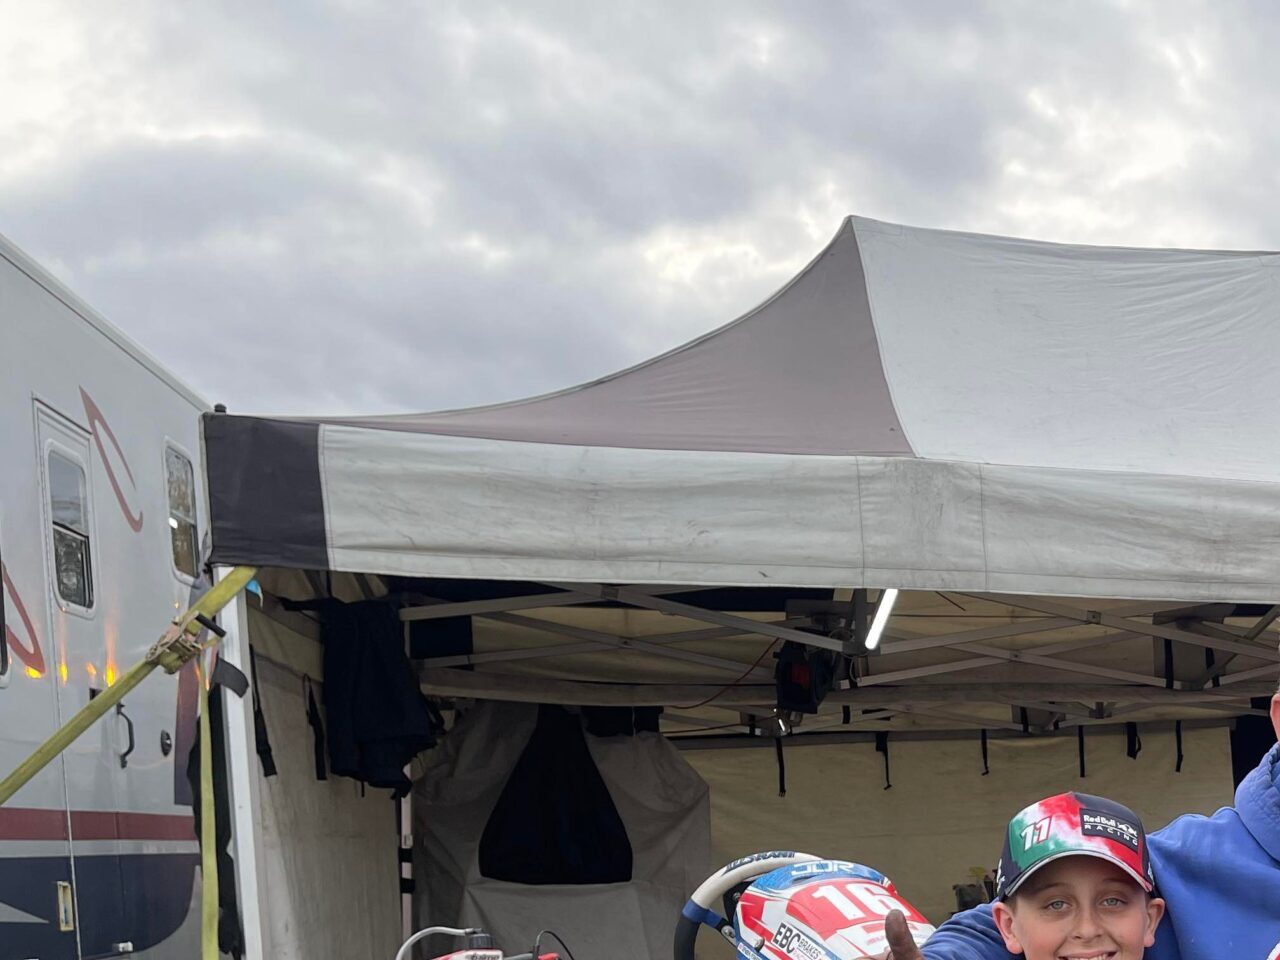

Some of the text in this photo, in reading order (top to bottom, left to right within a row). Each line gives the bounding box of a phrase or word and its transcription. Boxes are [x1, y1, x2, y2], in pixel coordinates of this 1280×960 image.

[1021, 815, 1052, 851] 11
[1084, 824, 1138, 846] RACING
[812, 882, 912, 921] 16
[773, 922, 801, 954] EBC
